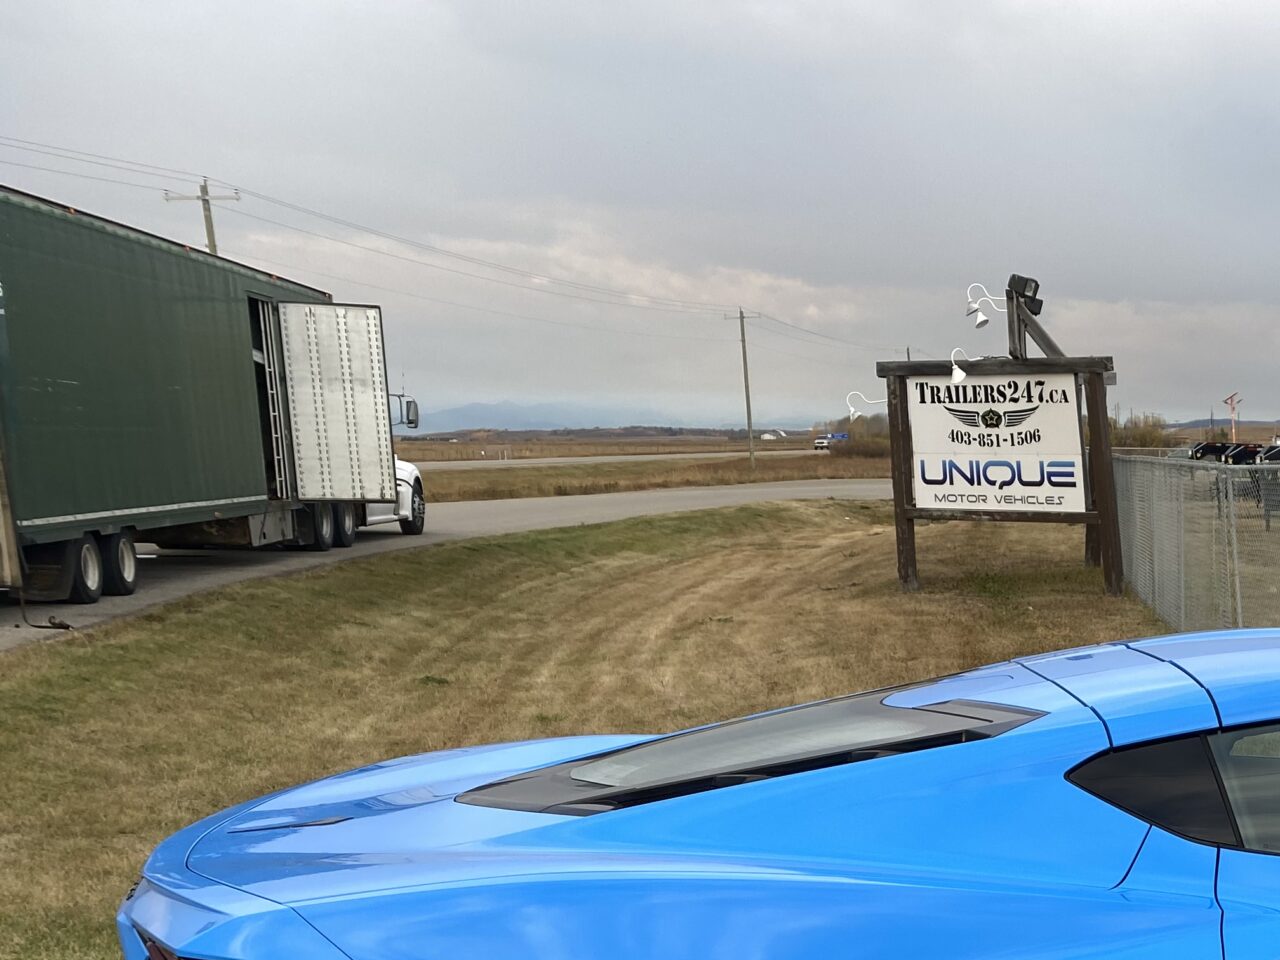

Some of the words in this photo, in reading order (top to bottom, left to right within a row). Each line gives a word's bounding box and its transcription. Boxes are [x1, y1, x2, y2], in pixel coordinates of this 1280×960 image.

[948, 428, 1041, 447] 403-851-1506
[919, 459, 1077, 490] UNIQUE
[934, 493, 988, 504] MOTOR
[994, 495, 1065, 505] VEHICLES
